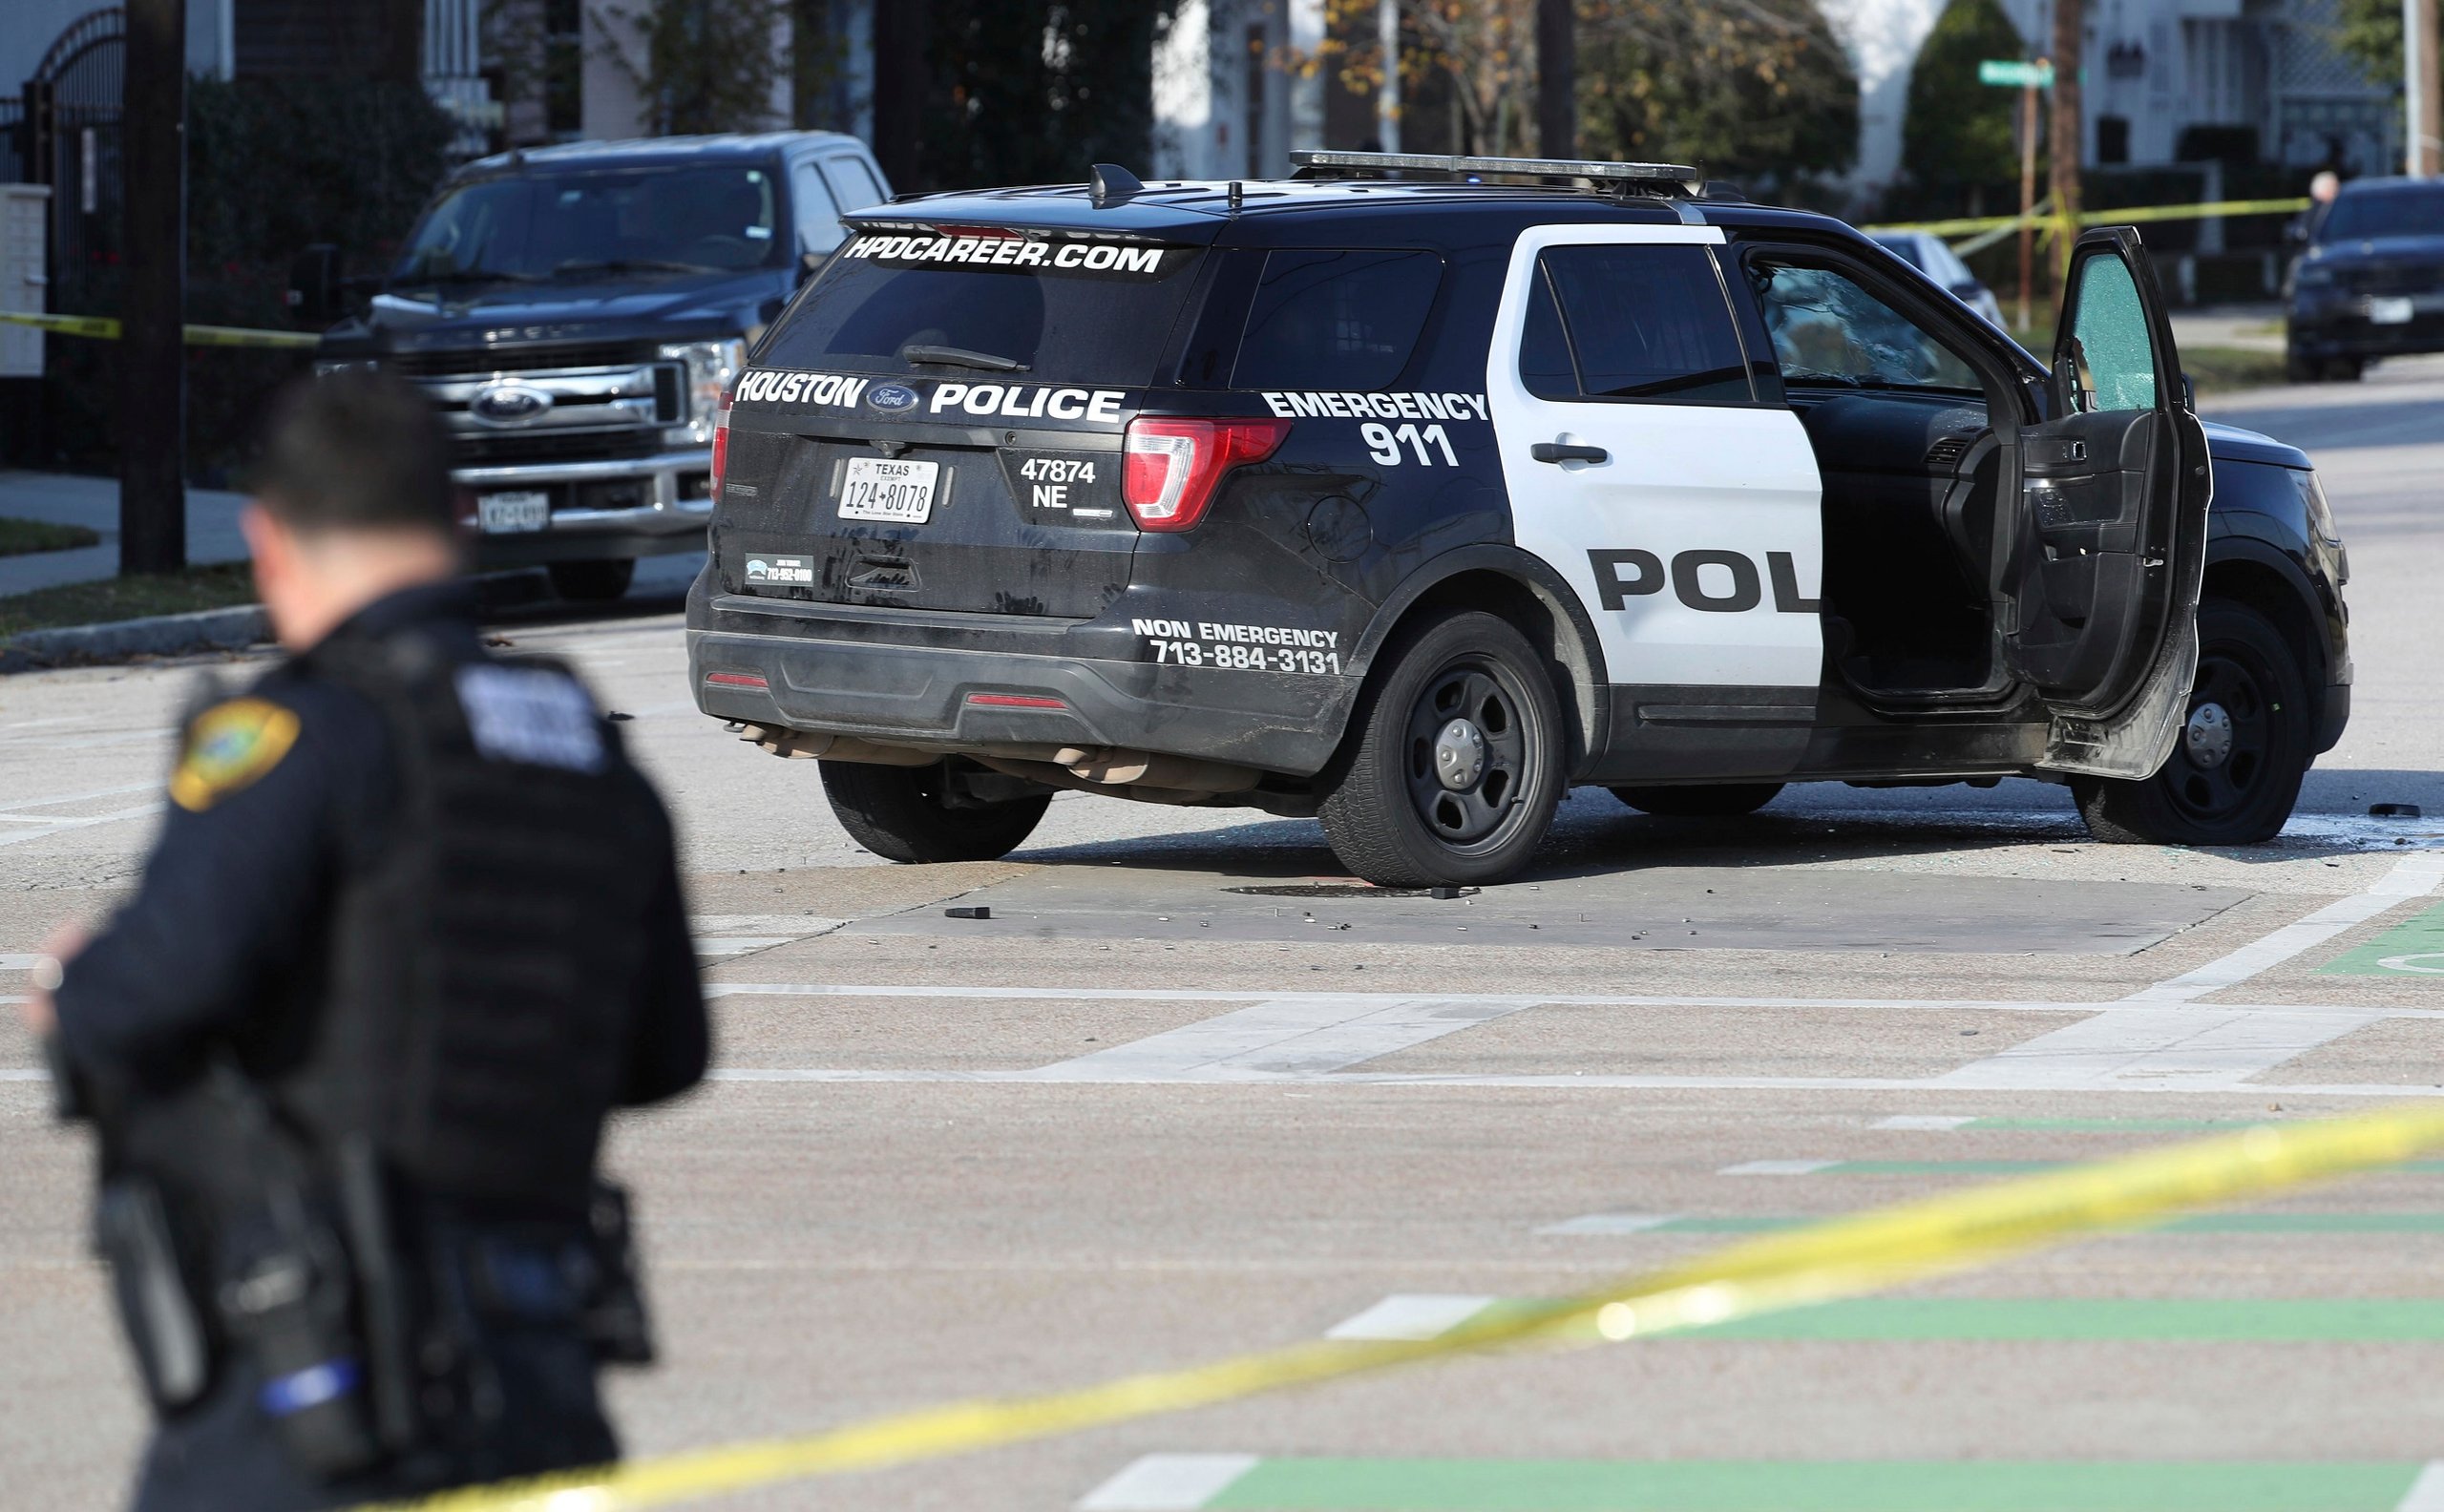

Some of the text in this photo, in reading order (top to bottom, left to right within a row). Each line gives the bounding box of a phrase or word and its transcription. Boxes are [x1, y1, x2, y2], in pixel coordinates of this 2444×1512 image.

[844, 236, 1164, 273] HPDCAREER.COM
[735, 371, 869, 409] HOUSTON
[875, 388, 905, 406] Ford
[930, 384, 1126, 423] POLICE
[1261, 392, 1489, 421] EMERGENCY
[1360, 422, 1459, 467] 911
[875, 464, 910, 475] TEXAS
[1021, 458, 1096, 483] 47874
[1033, 485, 1067, 508] NE
[1131, 619, 1338, 648] NON EMERGENCY
[1149, 640, 1340, 675] 713-884-3131
